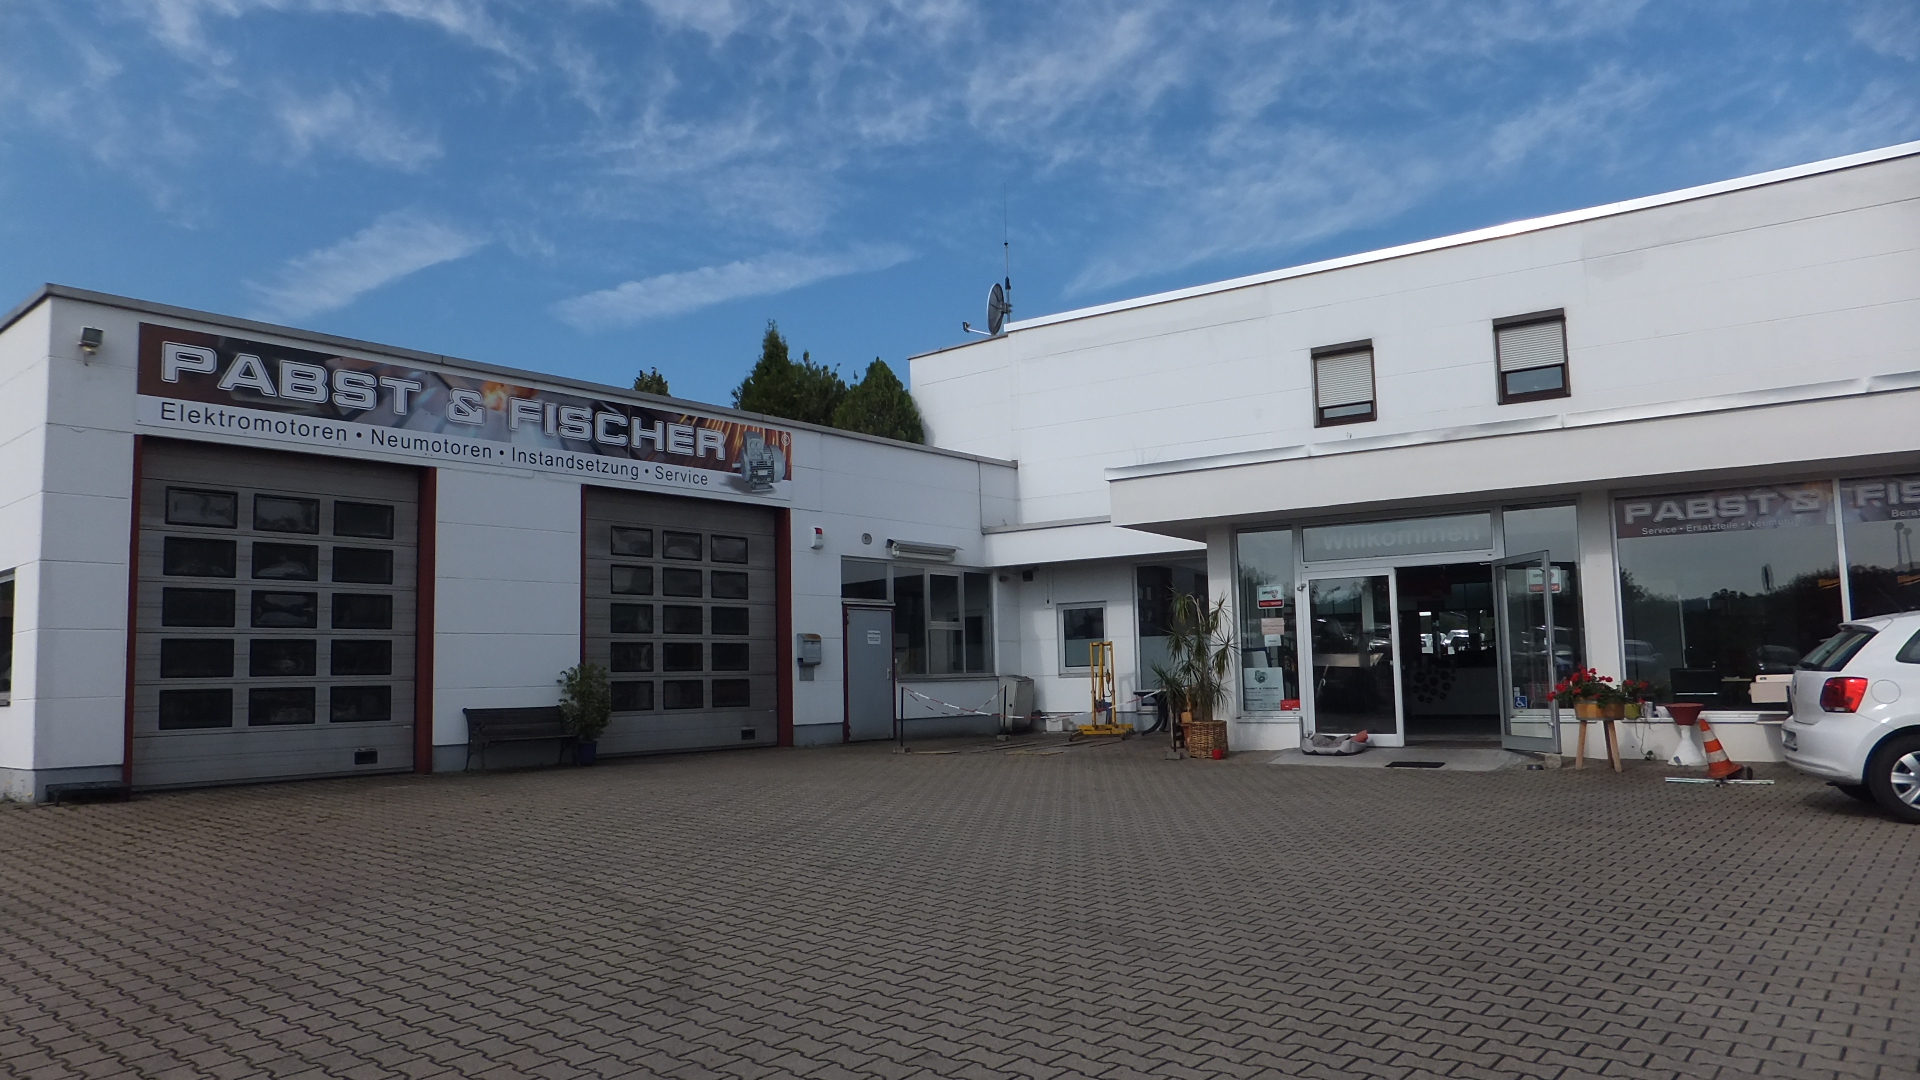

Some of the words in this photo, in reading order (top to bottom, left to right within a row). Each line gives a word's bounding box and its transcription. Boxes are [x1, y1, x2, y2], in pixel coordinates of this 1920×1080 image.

[161, 340, 421, 416] PABST
[446, 387, 485, 426] &
[508, 396, 725, 461] FISCHER
[161, 401, 347, 441] Elektromotoren
[371, 428, 491, 459] Neumotoren
[512, 446, 638, 480] Instandsetzung
[654, 465, 708, 486] Service
[1624, 491, 1778, 524] PABST
[1791, 489, 1821, 512] &
[1323, 525, 1480, 551] Willkommen
[1641, 524, 1677, 535] Service
[1686, 521, 1738, 532] Ersatzteile
